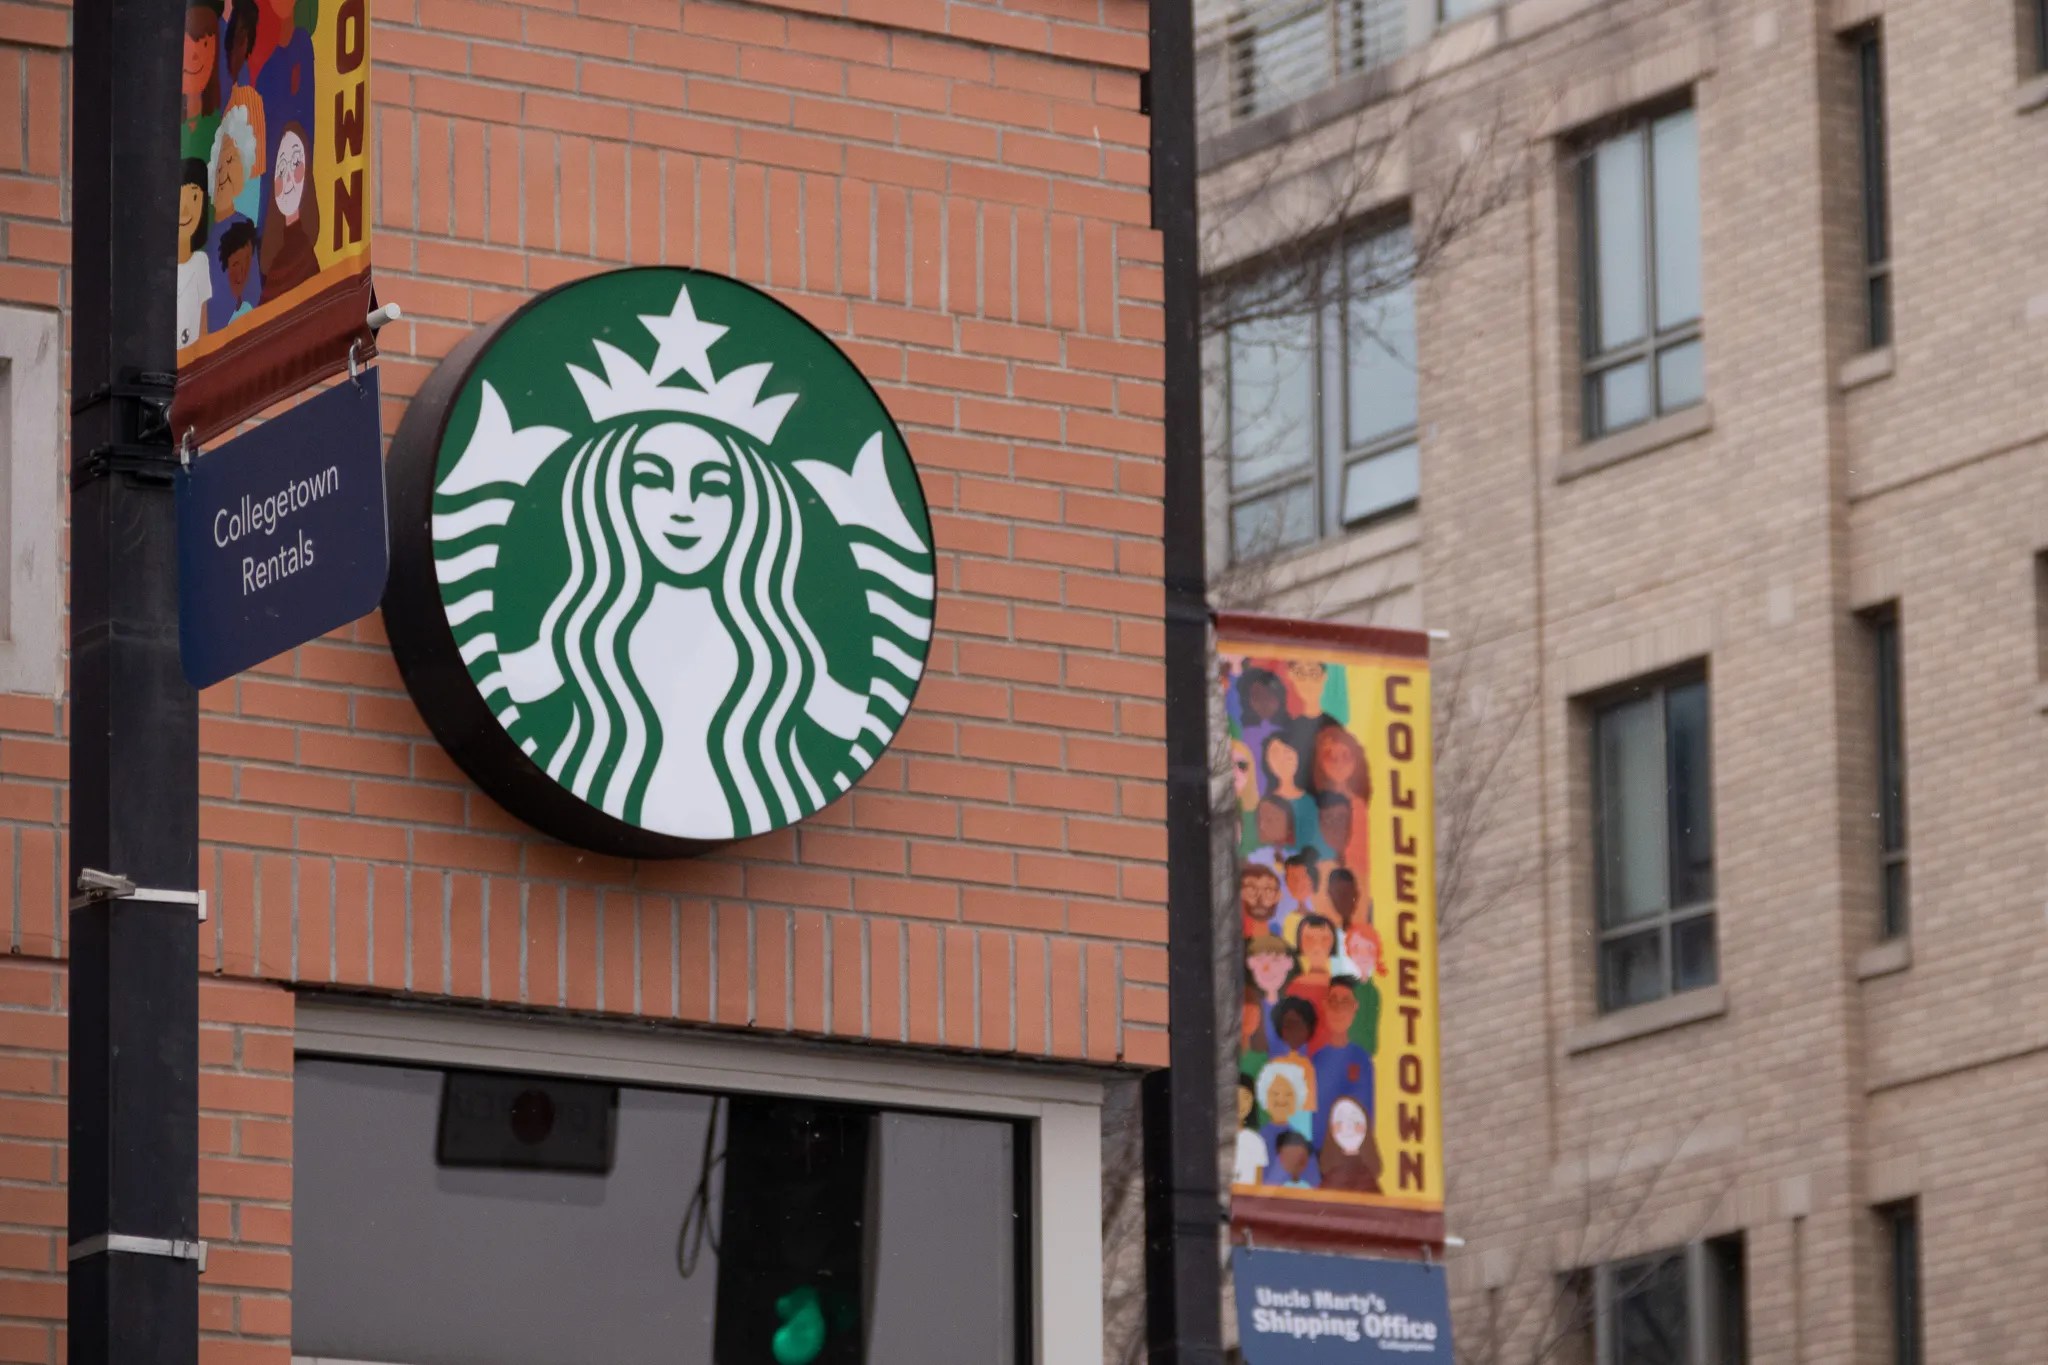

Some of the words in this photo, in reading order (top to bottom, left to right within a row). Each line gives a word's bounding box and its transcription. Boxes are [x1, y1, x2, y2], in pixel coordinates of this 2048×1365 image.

[214, 465, 339, 548] Collegetown
[242, 529, 314, 596] Rentals
[1384, 675, 1425, 1193] COLLEGETOWN
[1253, 1308, 1360, 1342] Shipping
[1363, 1313, 1438, 1340] Office
[1256, 1287, 1311, 1308] Uncle
[1314, 1290, 1386, 1314] Marty's
